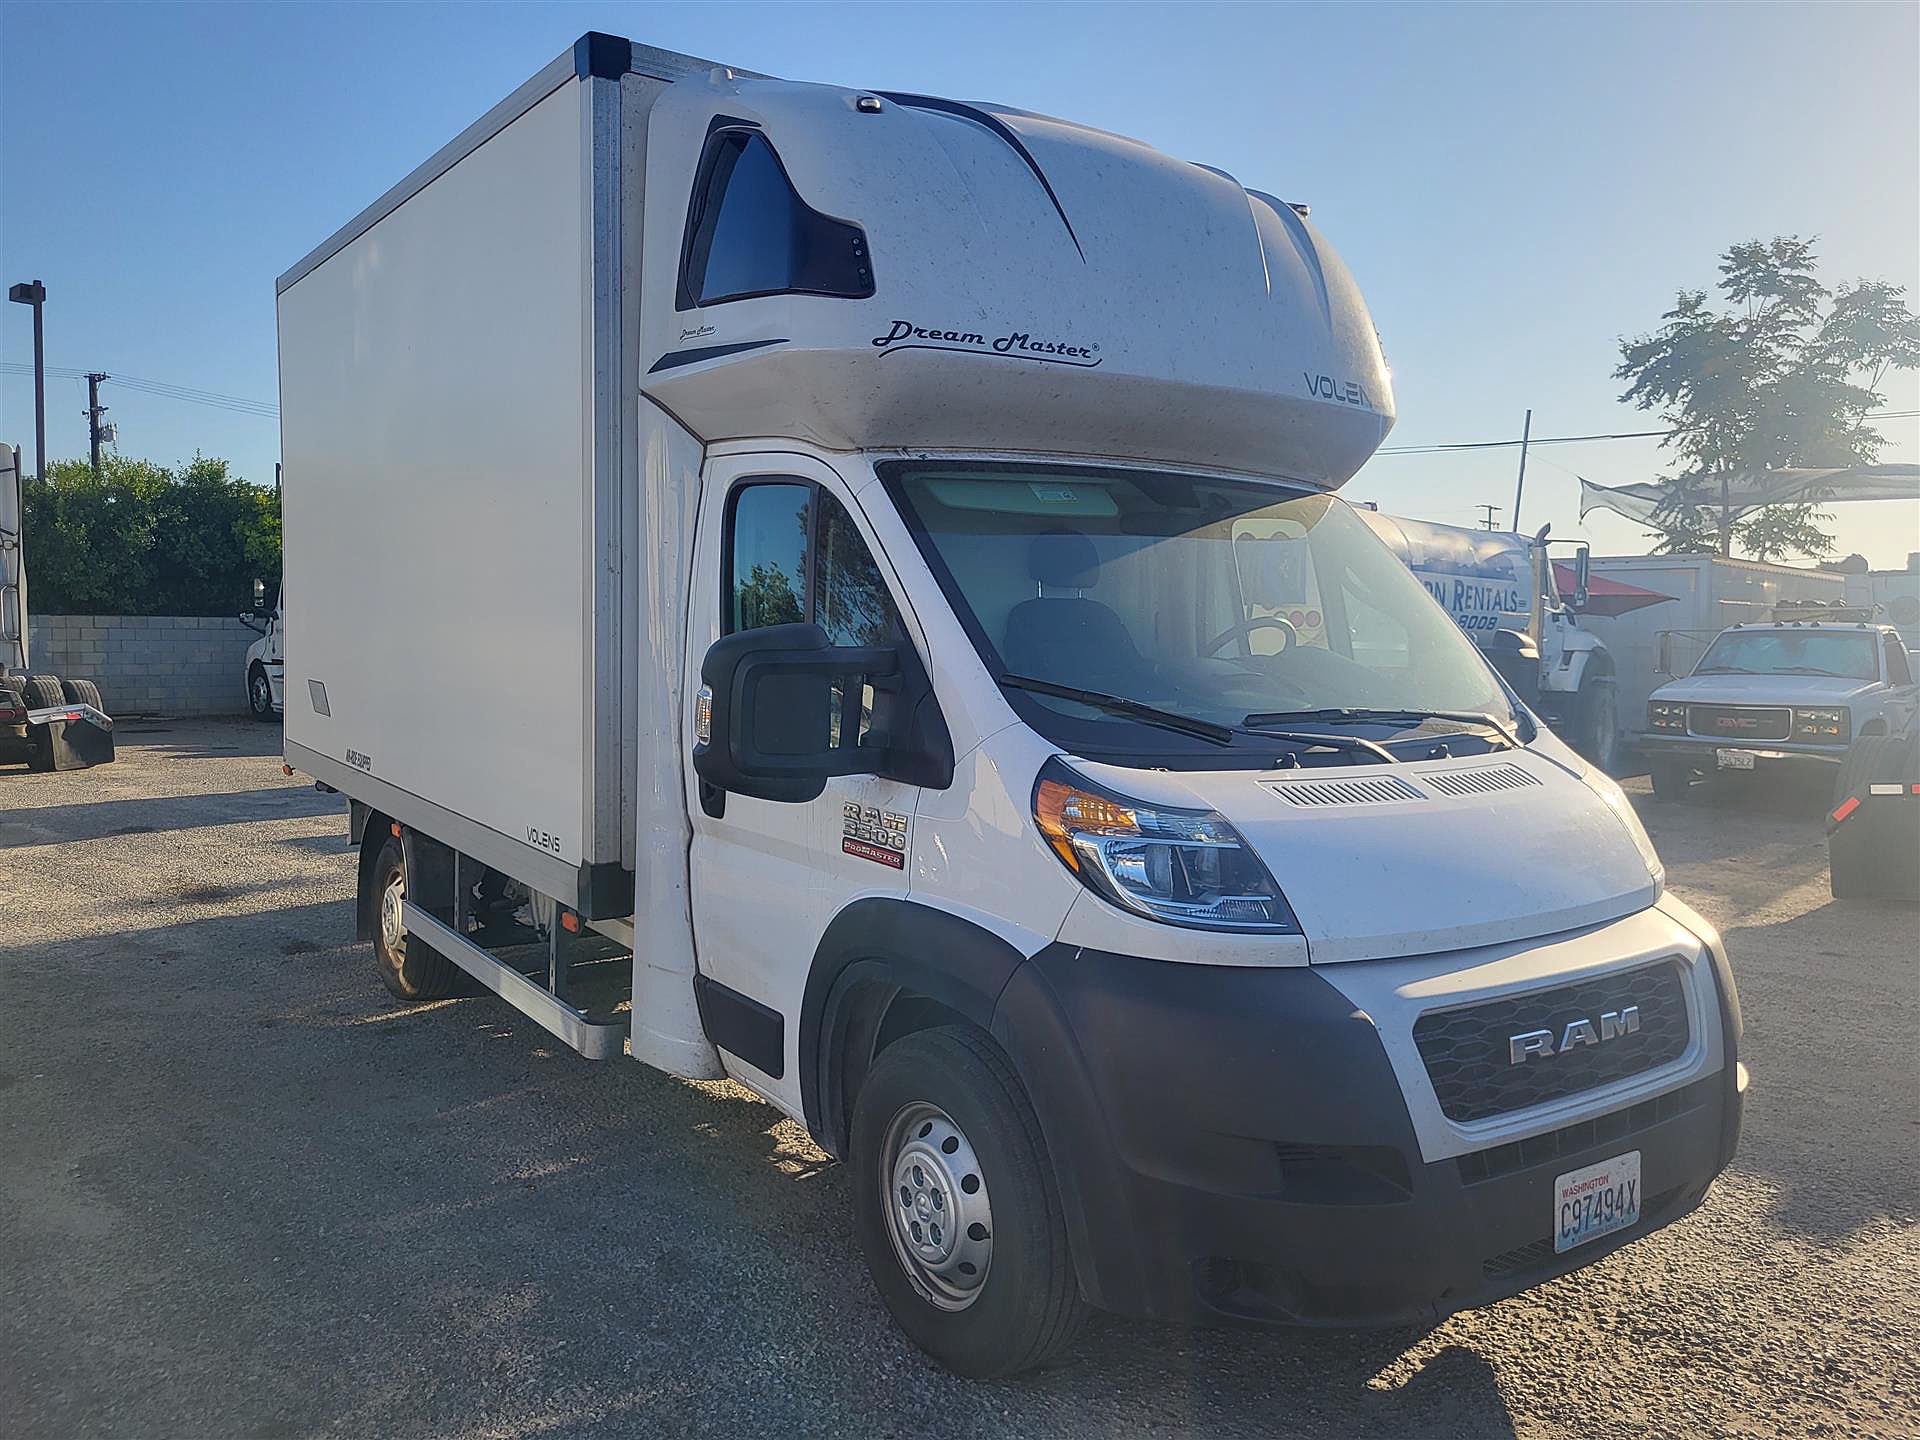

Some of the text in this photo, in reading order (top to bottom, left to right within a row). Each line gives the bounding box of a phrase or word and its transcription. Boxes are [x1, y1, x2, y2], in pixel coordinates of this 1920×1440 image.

[871, 320, 985, 347] Dream
[1452, 579, 1519, 612] RENTALS
[526, 825, 560, 853] VOLENS
[1509, 1005, 1641, 1065] RAM
[1562, 1175, 1609, 1199] WASHINGTON
[1561, 1178, 1636, 1239] C97494X
